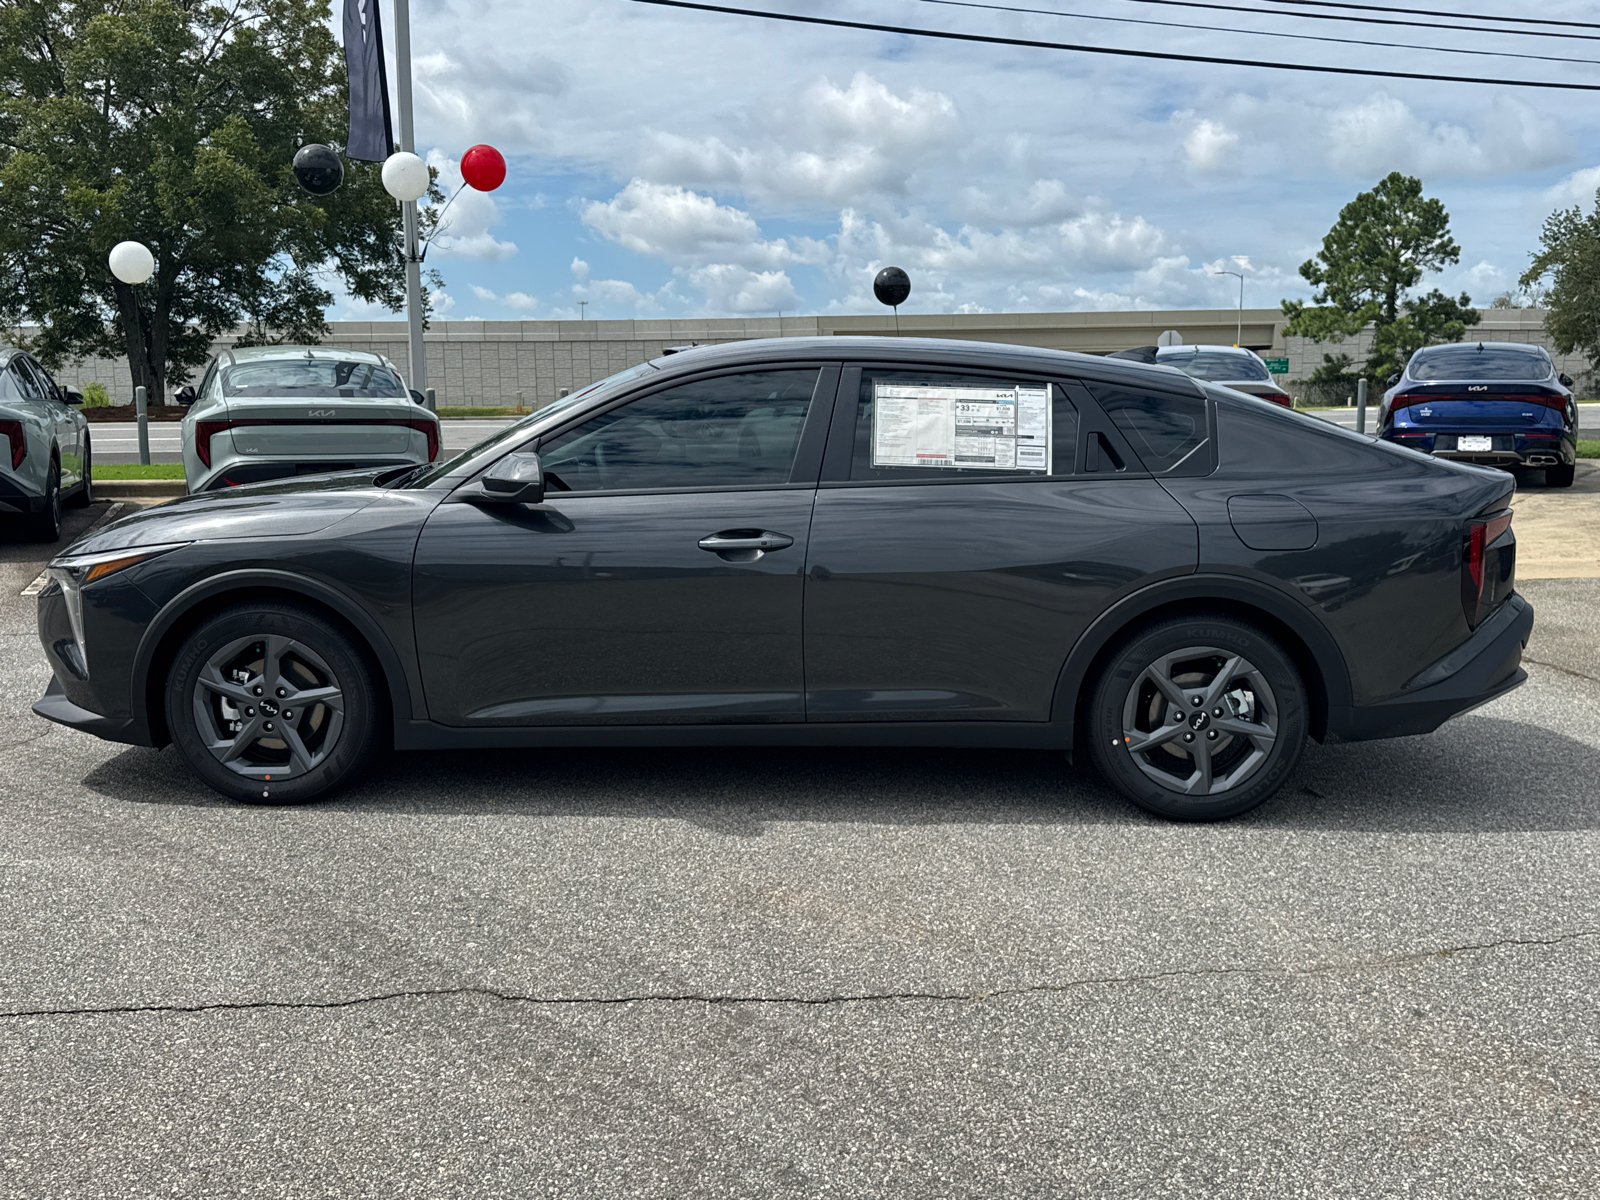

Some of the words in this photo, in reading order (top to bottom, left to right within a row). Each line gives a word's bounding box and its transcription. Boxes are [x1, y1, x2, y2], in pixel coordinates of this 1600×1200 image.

[308, 409, 336, 417] KIA
[960, 404, 970, 412] 33
[1187, 628, 1250, 647] KUMHO
[174, 639, 208, 692] KUMHO
[259, 701, 278, 715] KIA
[1192, 711, 1207, 730] KIA
[1239, 758, 1287, 802] SOLUS
